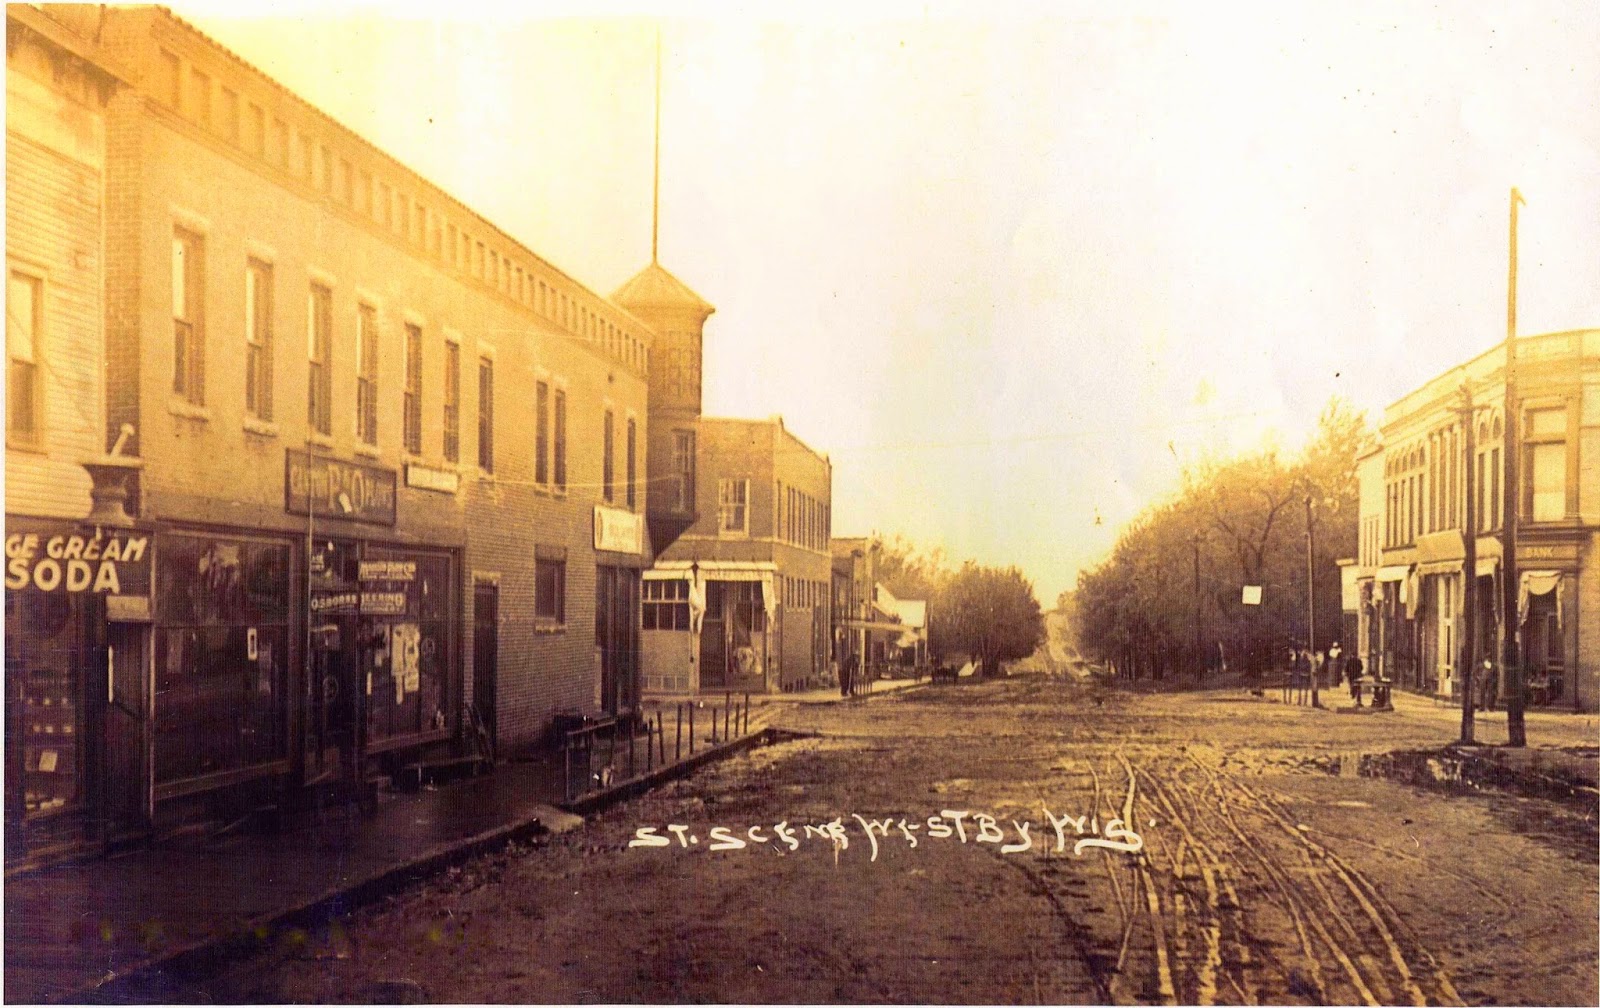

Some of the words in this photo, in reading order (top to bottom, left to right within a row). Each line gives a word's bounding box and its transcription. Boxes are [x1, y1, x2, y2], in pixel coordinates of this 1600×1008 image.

[5, 533, 39, 559] CE
[1525, 546, 1553, 558] BANK
[5, 558, 120, 594] SODA
